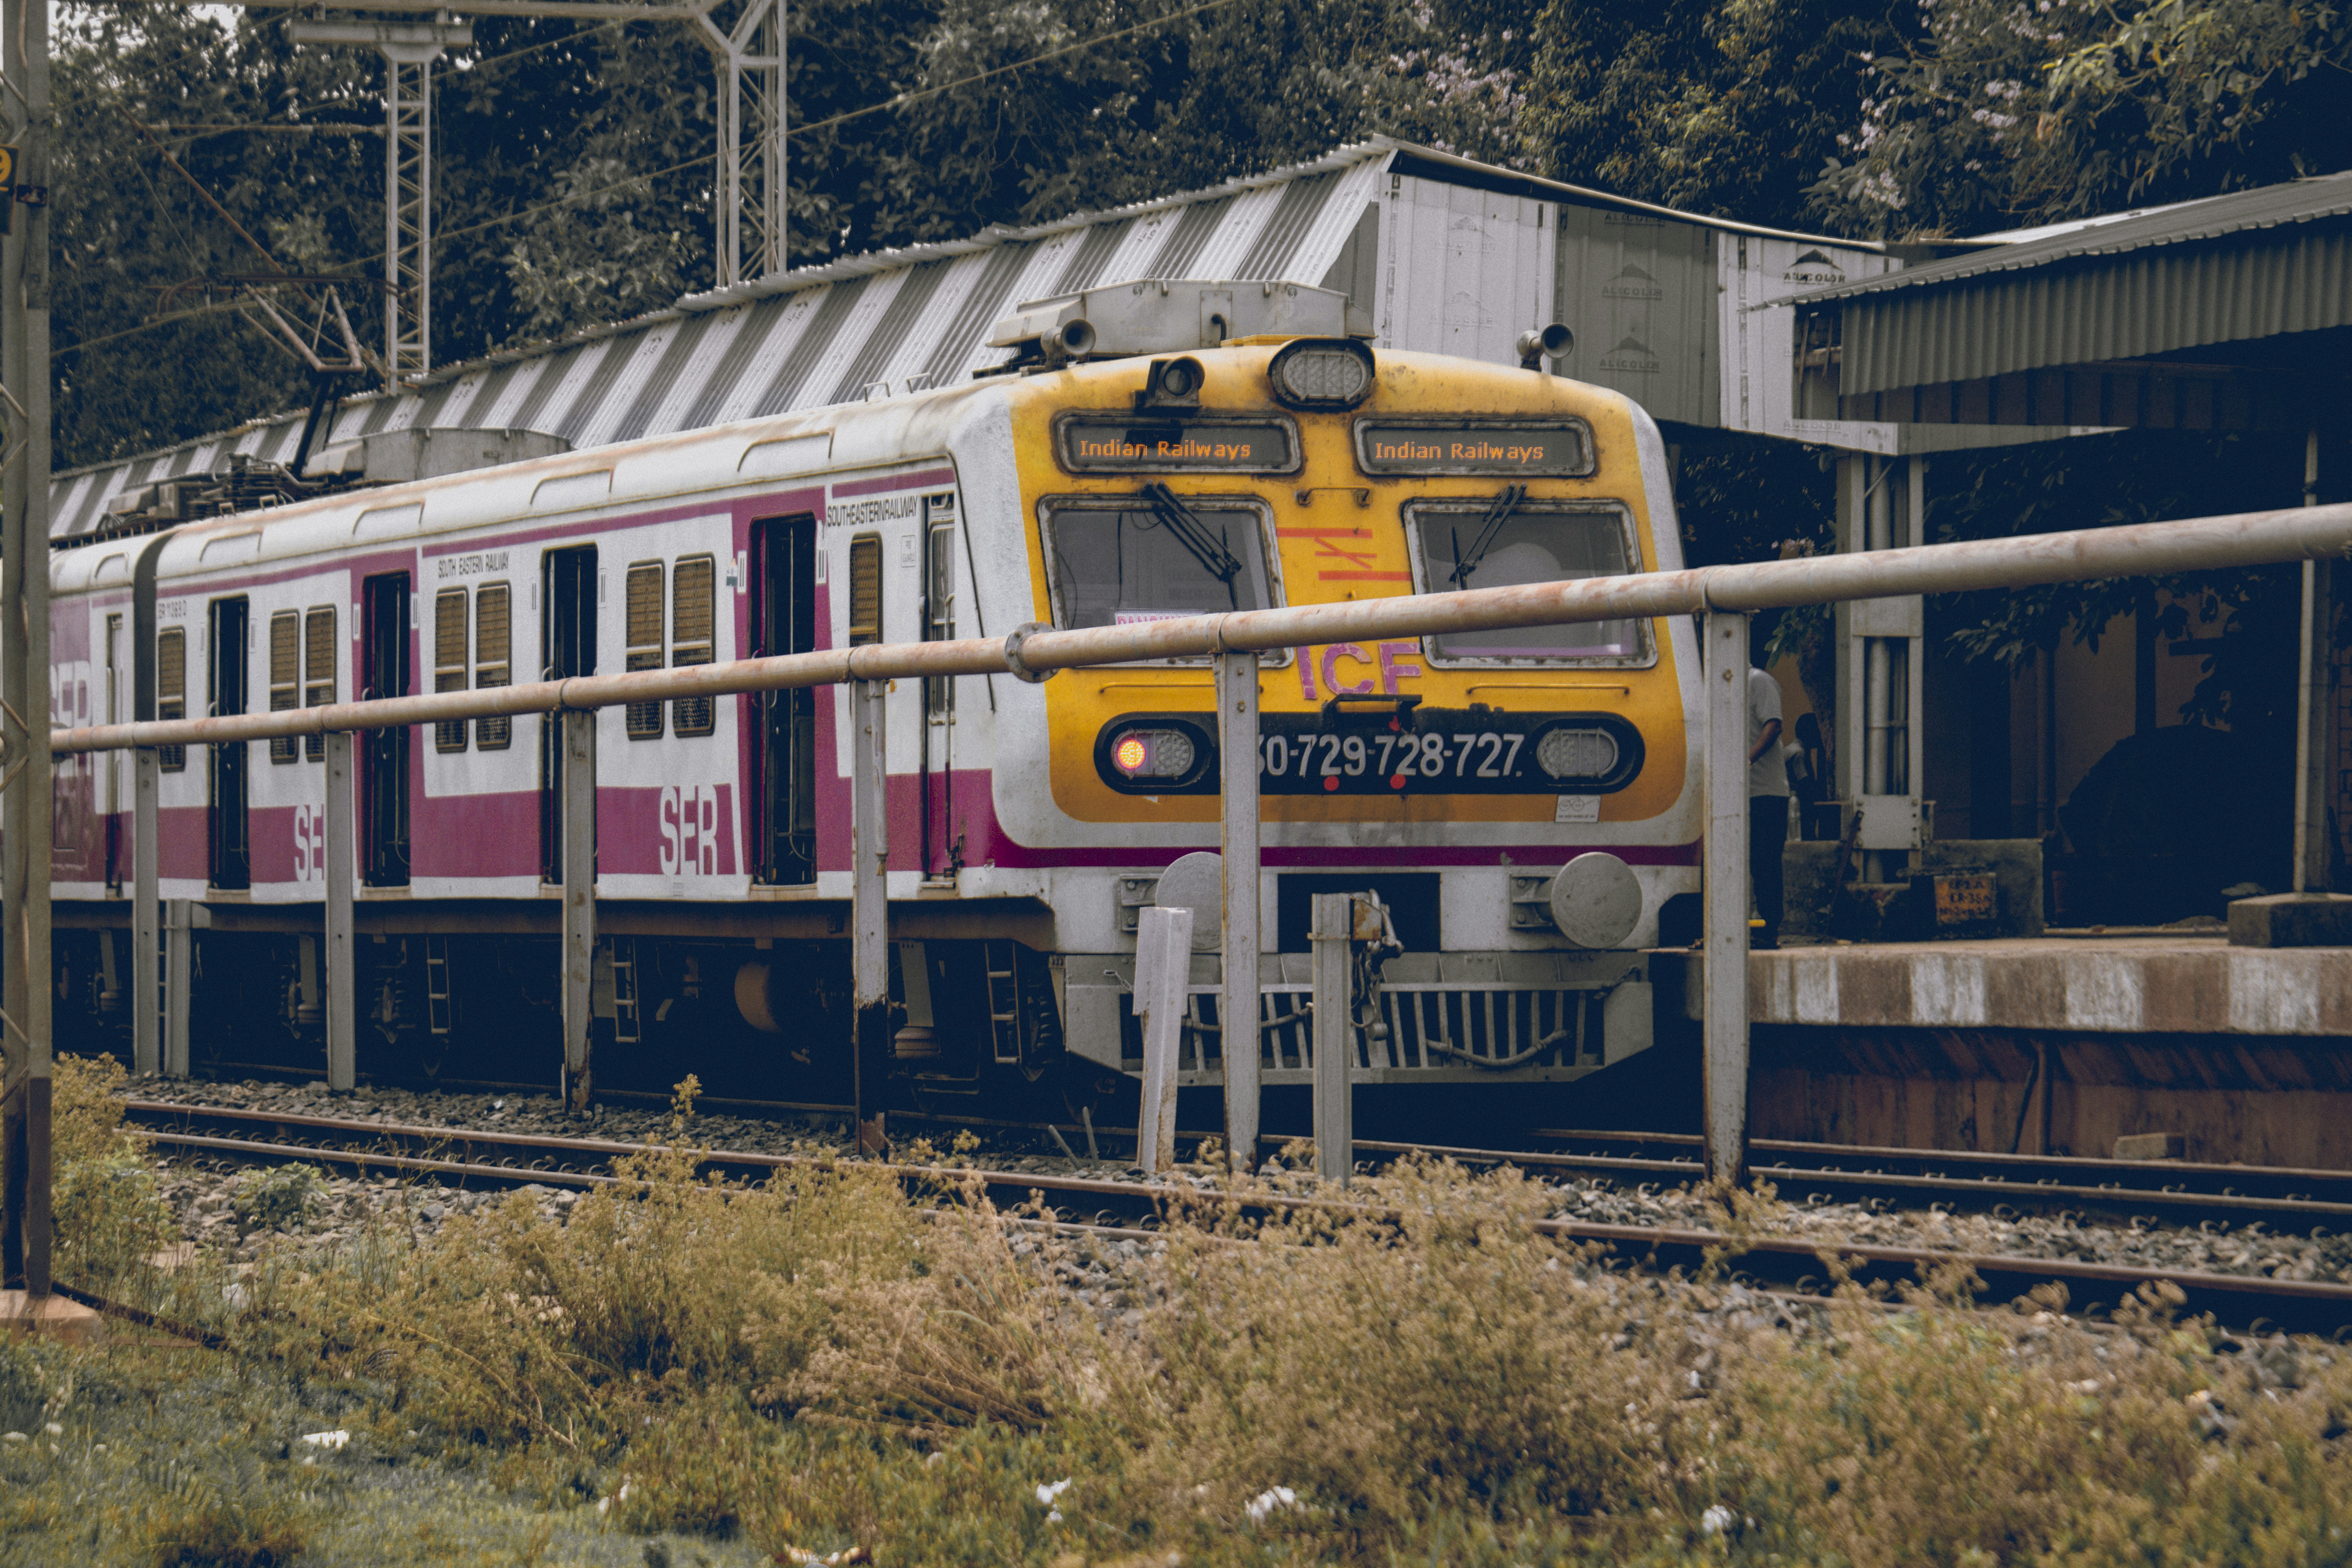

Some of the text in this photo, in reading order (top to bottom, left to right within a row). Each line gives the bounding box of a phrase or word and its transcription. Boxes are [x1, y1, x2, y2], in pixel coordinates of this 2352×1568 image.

[1080, 439, 1251, 461] Indian Railways
[1375, 442, 1543, 464] Indian Railways
[438, 551, 510, 578] SOUTH EASTERN RAILWAY
[1297, 642, 1422, 700] ICF
[294, 803, 327, 882] SE
[659, 784, 718, 875] SER
